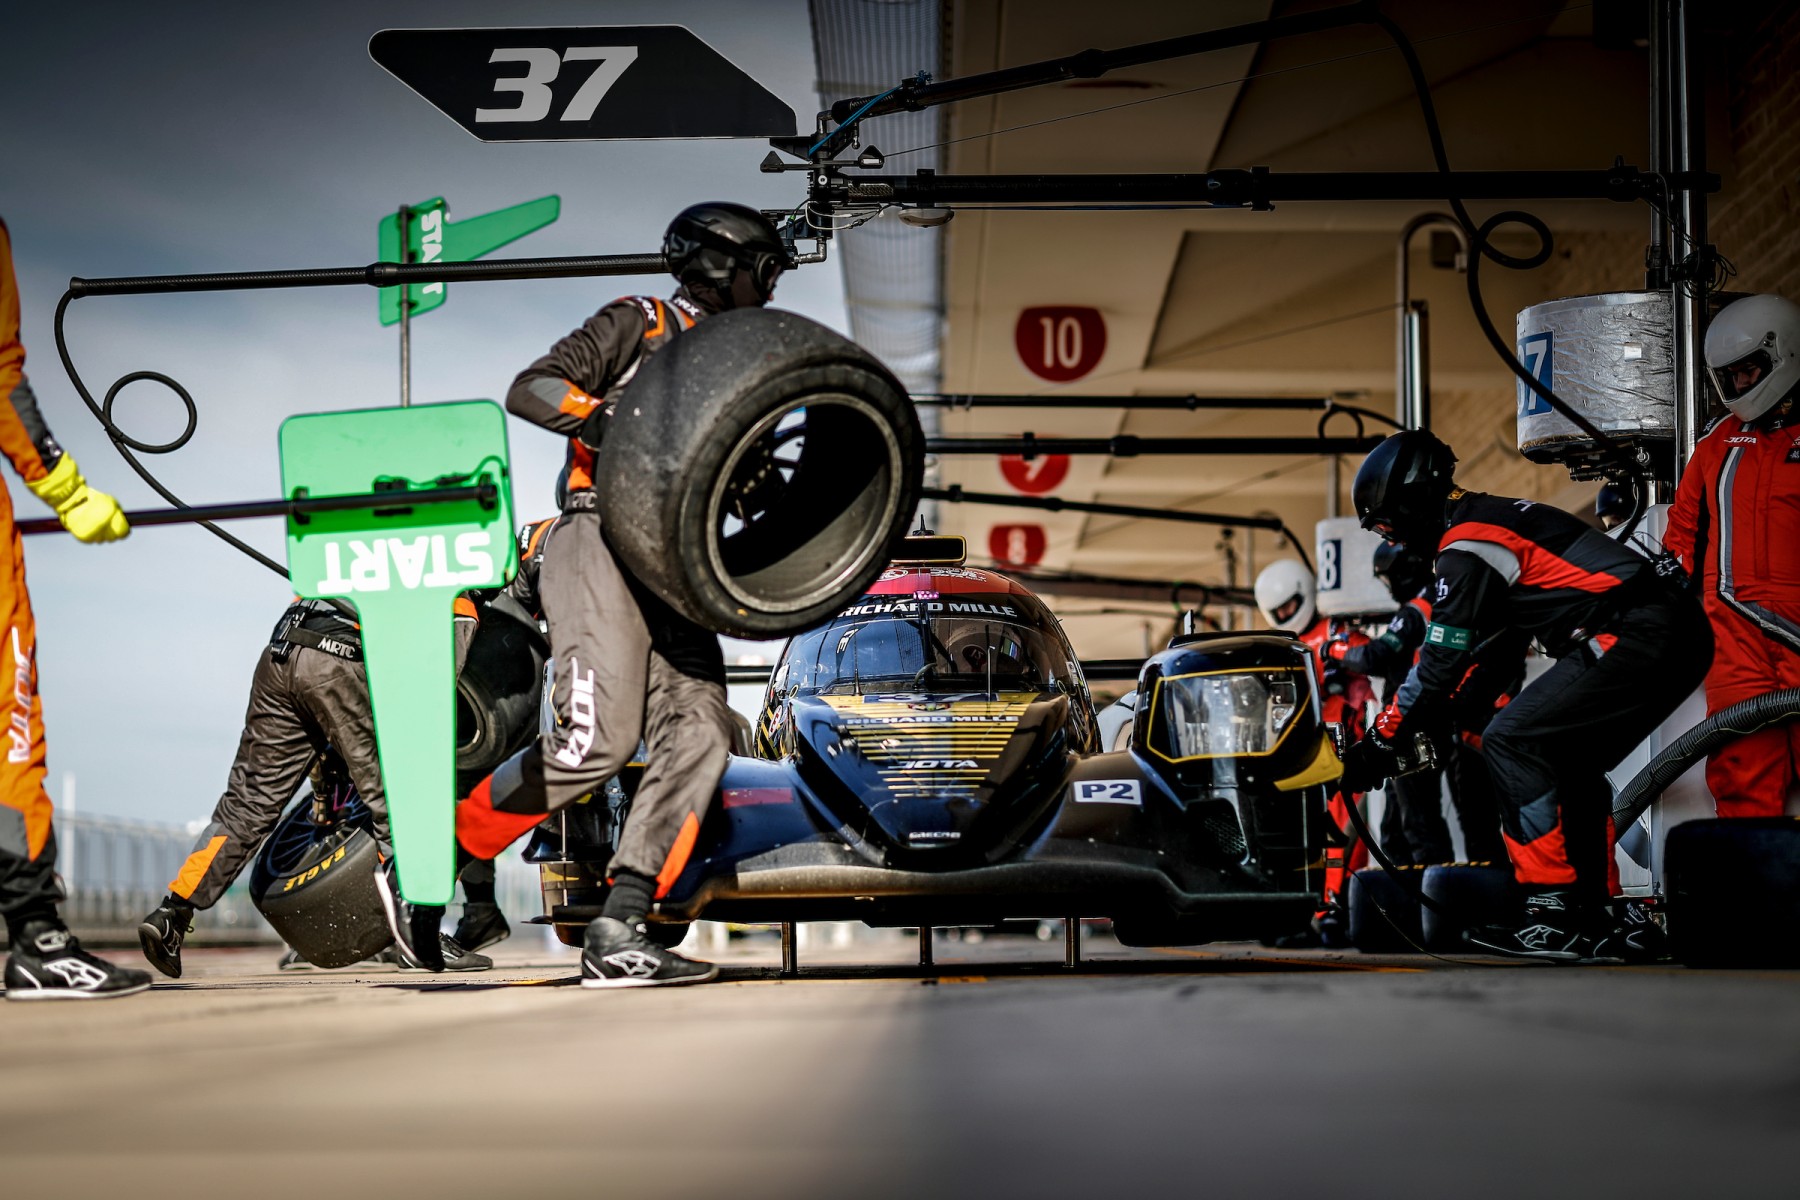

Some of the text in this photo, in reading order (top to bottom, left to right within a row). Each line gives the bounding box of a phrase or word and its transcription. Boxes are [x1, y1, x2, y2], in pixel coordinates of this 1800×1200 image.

[475, 46, 638, 123] 37
[421, 209, 443, 294] STAT
[1040, 317, 1082, 369] 10
[1723, 436, 1757, 444] JOTA
[317, 531, 494, 595] START
[1008, 528, 1027, 565] 8
[837, 602, 1018, 618] RICHARD MILLE
[317, 637, 356, 658] MRTC
[7, 626, 33, 763] JOTA
[555, 656, 596, 768] JOTA
[846, 715, 1019, 724] RICHARD MILLE
[888, 759, 979, 769] JOTA
[1082, 783, 1135, 800] P2
[283, 846, 346, 892] EAGLE
